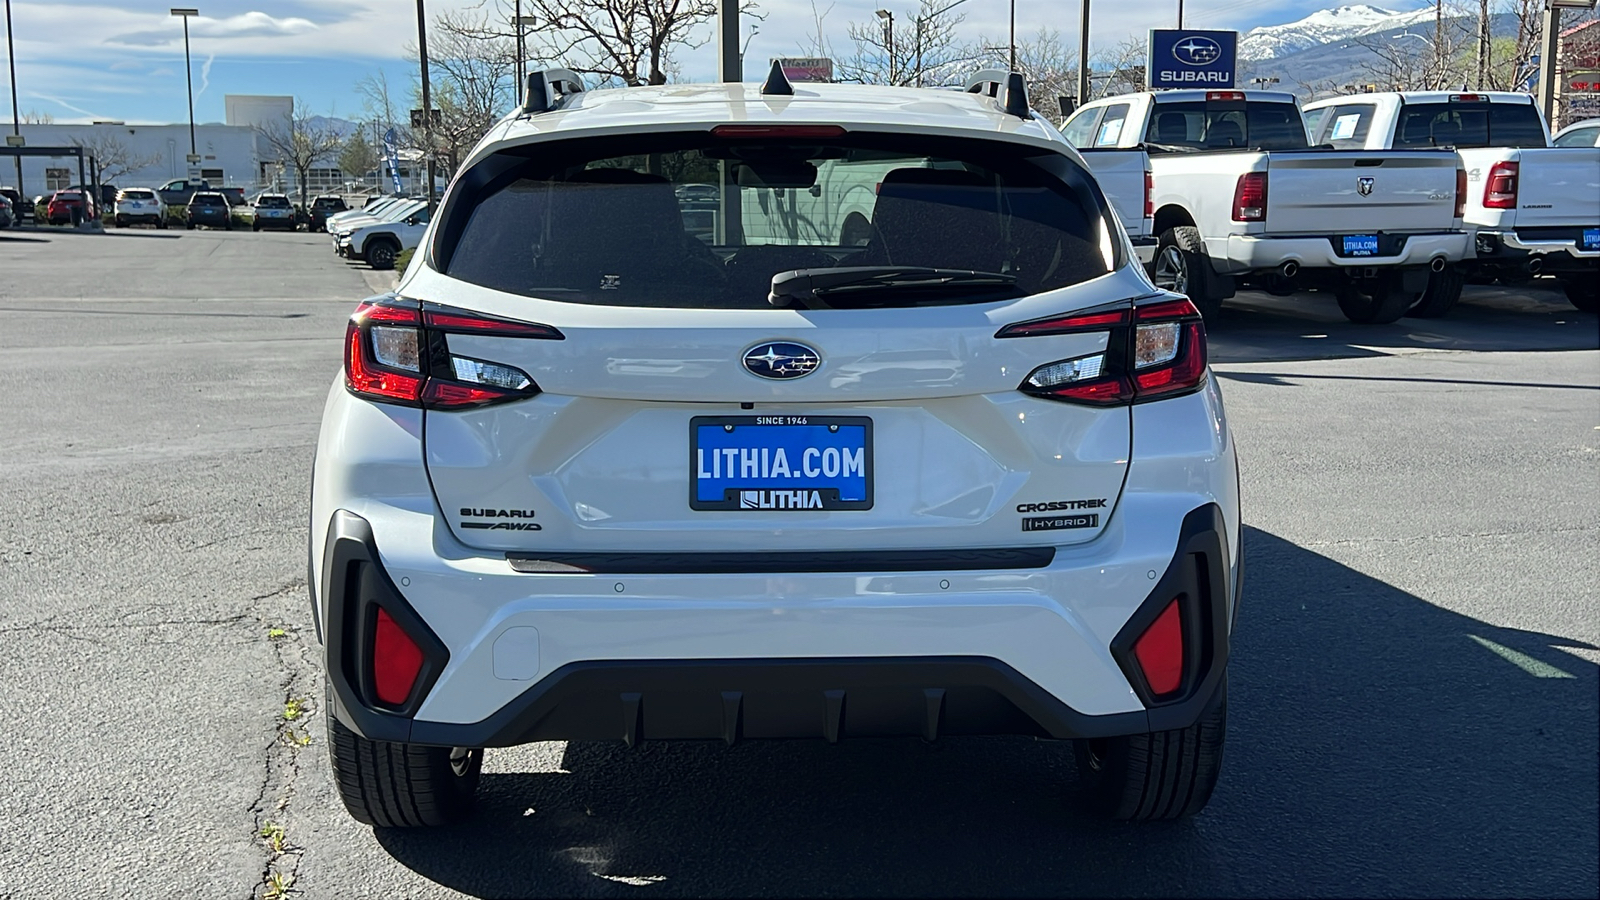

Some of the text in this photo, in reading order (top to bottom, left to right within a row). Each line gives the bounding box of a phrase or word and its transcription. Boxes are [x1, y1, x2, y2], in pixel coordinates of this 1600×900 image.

[1160, 70, 1229, 82] SUBARU
[1343, 241, 1378, 250] LITHIA.COM
[756, 417, 808, 425] SINCE 1946
[697, 447, 865, 479] LITHIA.COM
[759, 490, 823, 509] LITHIA
[1016, 498, 1107, 513] CROSSTREK
[460, 508, 535, 518] SUBARU
[490, 522, 543, 531] AWD
[1034, 518, 1087, 528] HYBRID
